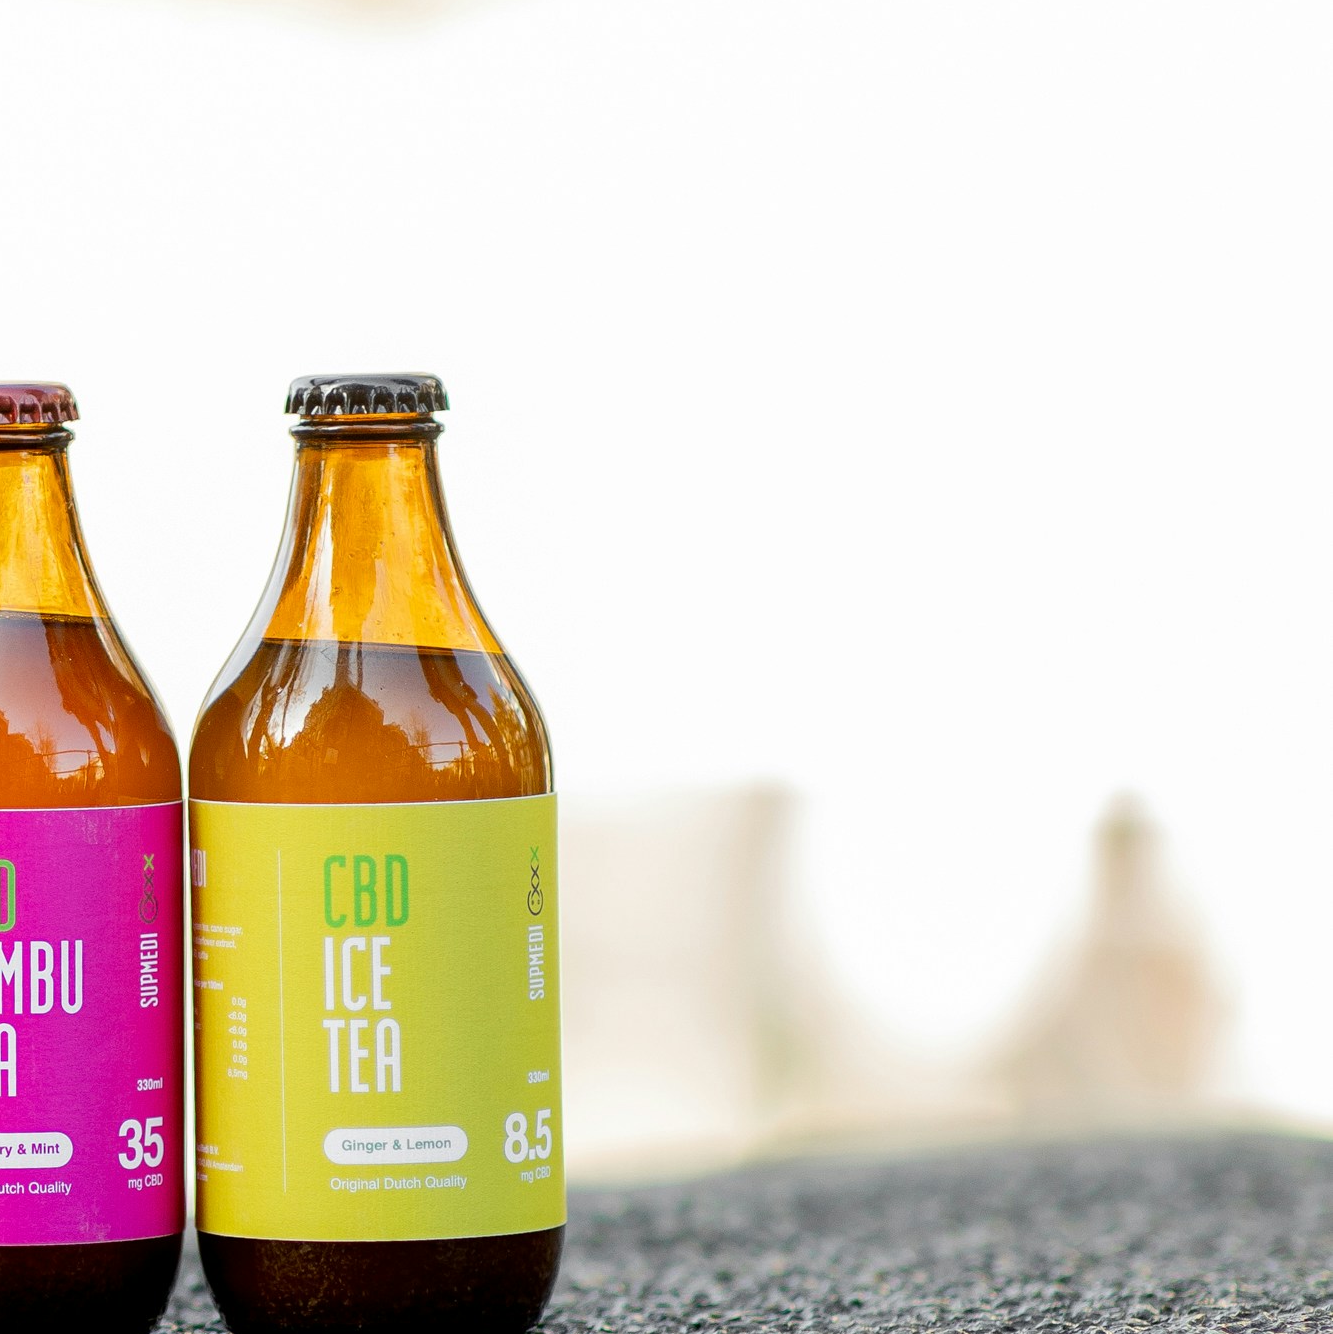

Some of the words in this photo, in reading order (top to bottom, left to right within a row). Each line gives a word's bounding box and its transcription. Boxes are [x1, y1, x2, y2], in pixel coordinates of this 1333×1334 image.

[323, 853, 410, 928] CBD
[140, 932, 159, 1009] SUPMEDI
[527, 924, 545, 1001] SUPMEDI
[324, 936, 392, 1011] ICE
[322, 1018, 402, 1093] TEA
[137, 1077, 163, 1092] 330ml
[528, 1070, 550, 1084] 330ml
[118, 1116, 165, 1170] 35
[504, 1108, 553, 1164] 8.5
[17, 1144, 27, 1155] &
[31, 1142, 60, 1155] Mint
[341, 1139, 387, 1154] Ginger
[392, 1140, 402, 1151] &
[406, 1138, 452, 1150] Lemon
[128, 1178, 143, 1191] mg
[144, 1173, 163, 1188] CBD
[521, 1171, 534, 1183] mg
[535, 1166, 551, 1180] CBD
[28, 1181, 72, 1196] Quality
[330, 1176, 380, 1193] Original
[384, 1176, 422, 1190] Dutch
[425, 1175, 467, 1190] Quality
